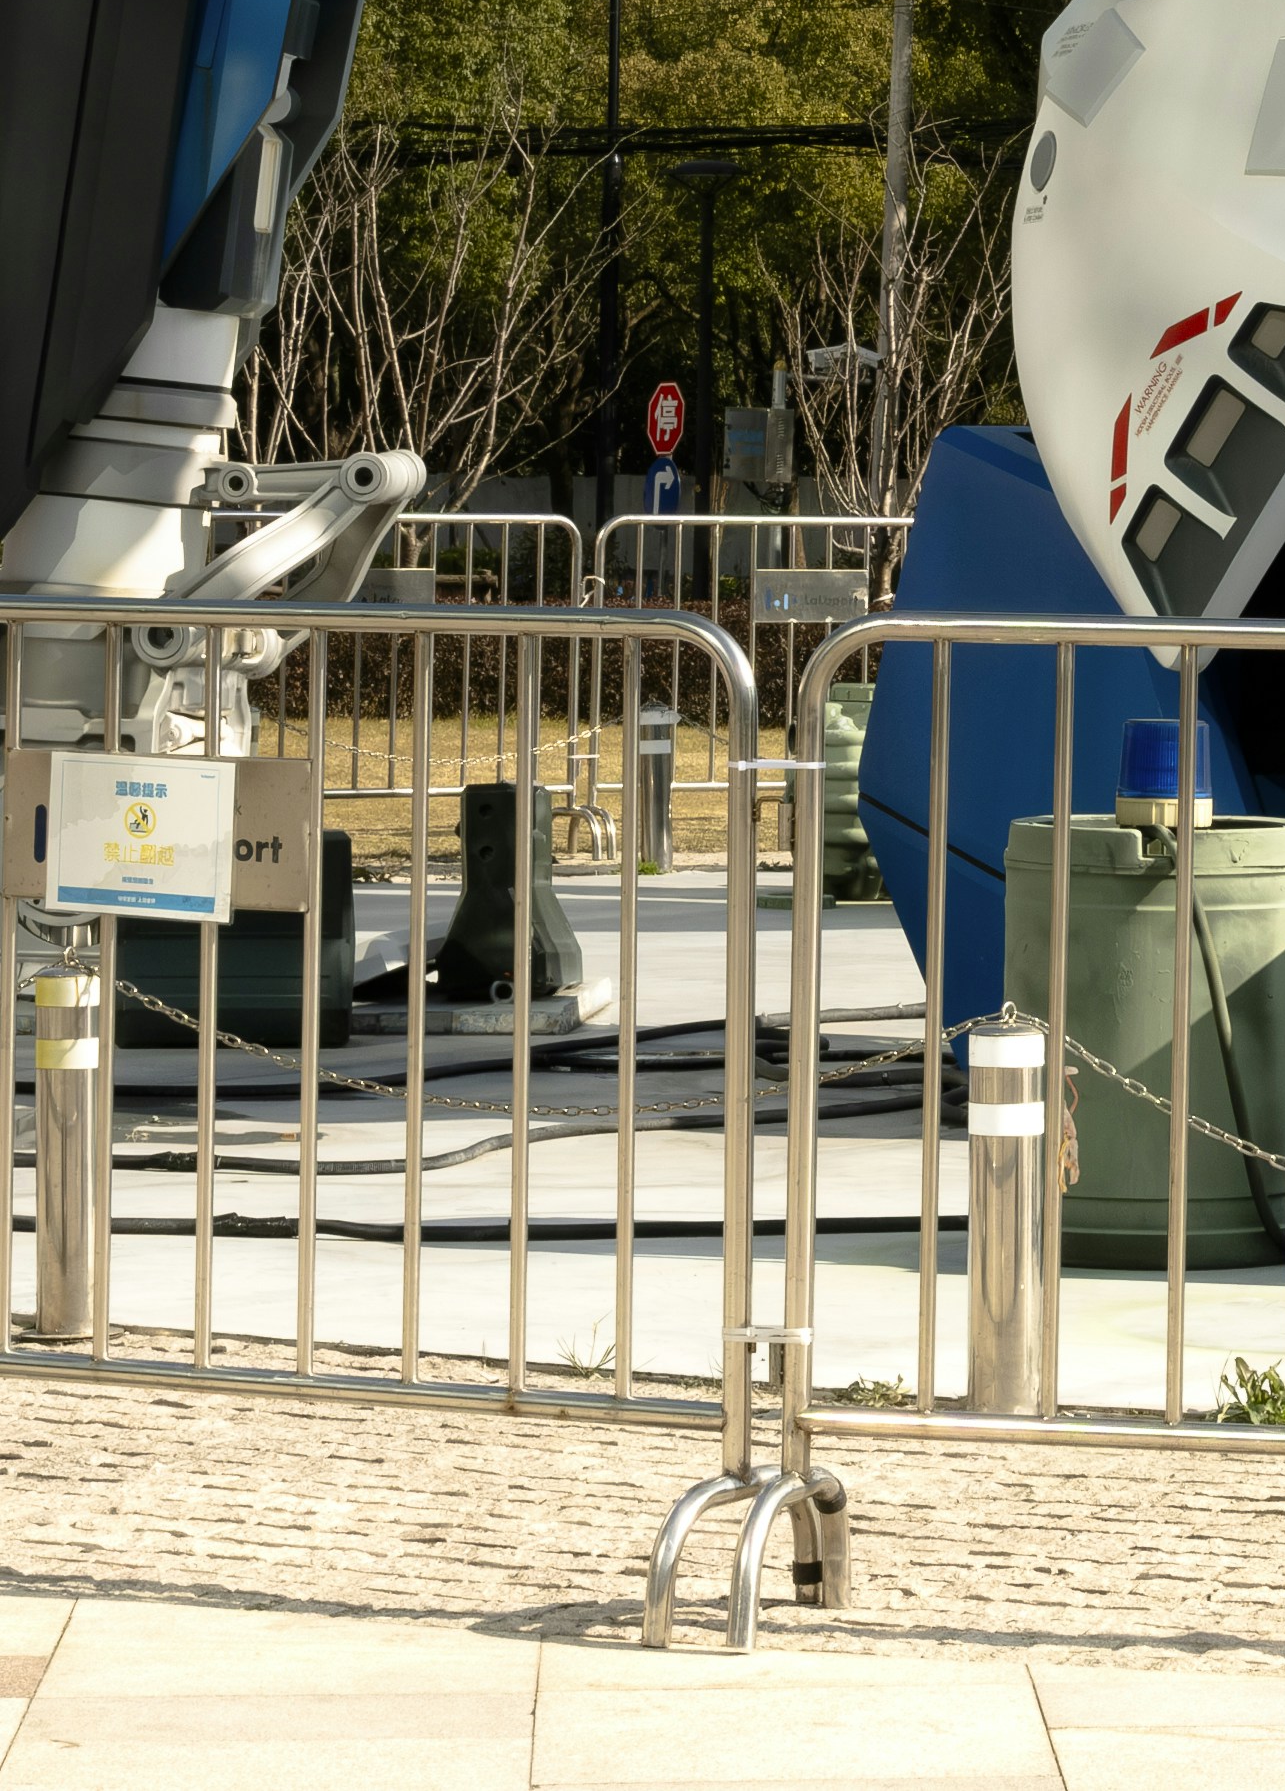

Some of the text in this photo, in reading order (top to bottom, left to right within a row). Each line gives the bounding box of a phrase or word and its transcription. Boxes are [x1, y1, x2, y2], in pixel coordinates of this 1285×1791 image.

[1131, 358, 1170, 415] WARNING
[655, 394, 678, 442] 停
[104, 842, 175, 866] 禁止翻越
